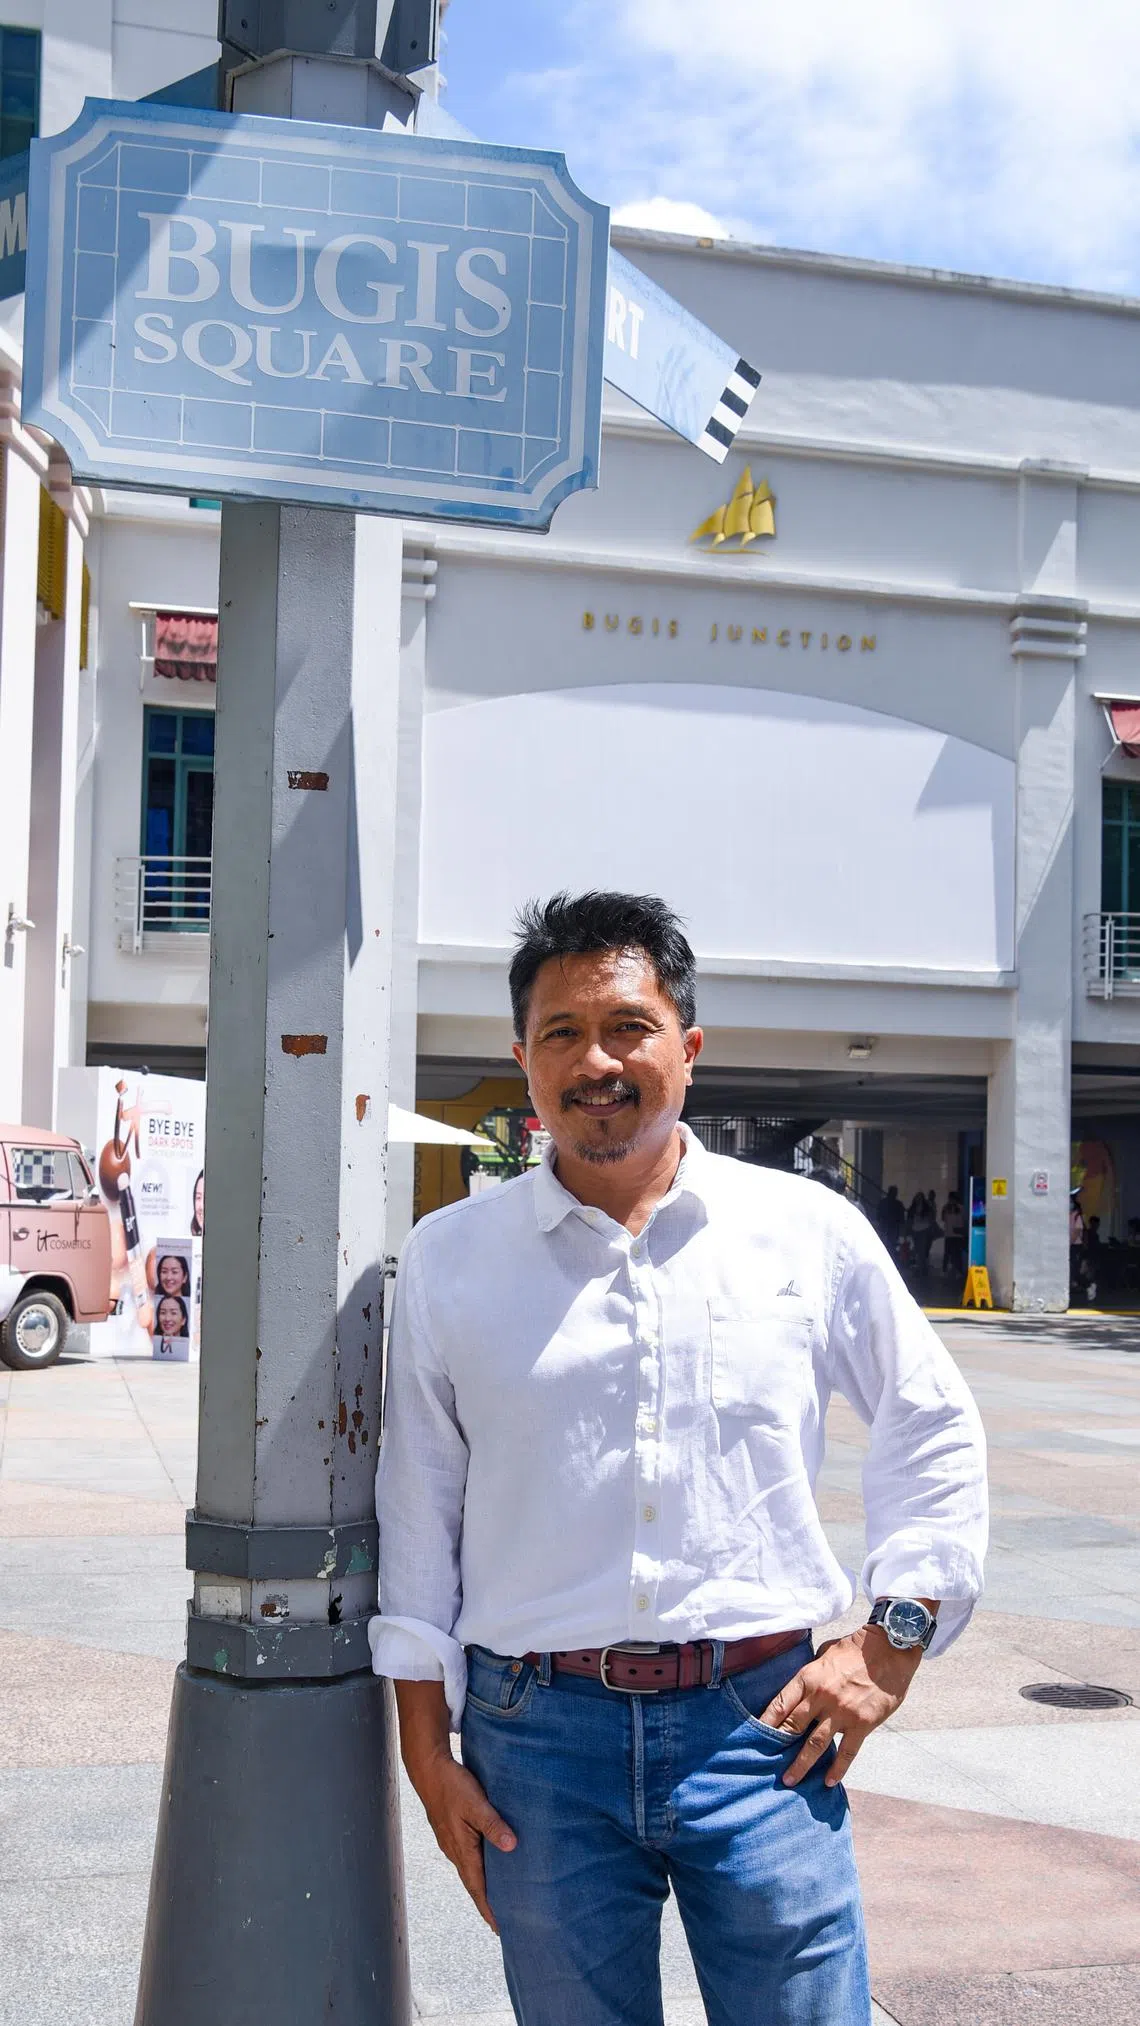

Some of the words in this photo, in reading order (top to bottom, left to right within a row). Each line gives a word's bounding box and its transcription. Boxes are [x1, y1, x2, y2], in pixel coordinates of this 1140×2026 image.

[136, 212, 511, 338] BUGIS
[134, 313, 507, 402] SQUARE
[582, 611, 678, 639] BUGIS
[708, 622, 877, 652] JUNCTION
[149, 1118, 170, 1136] BYE
[174, 1121, 195, 1138] BYE
[148, 1136, 170, 1147] DARK
[171, 1137, 194, 1150] SPOTS
[141, 1183, 163, 1194] NEW!
[37, 1229, 59, 1252] it
[50, 1239, 92, 1250] COSMETICS
